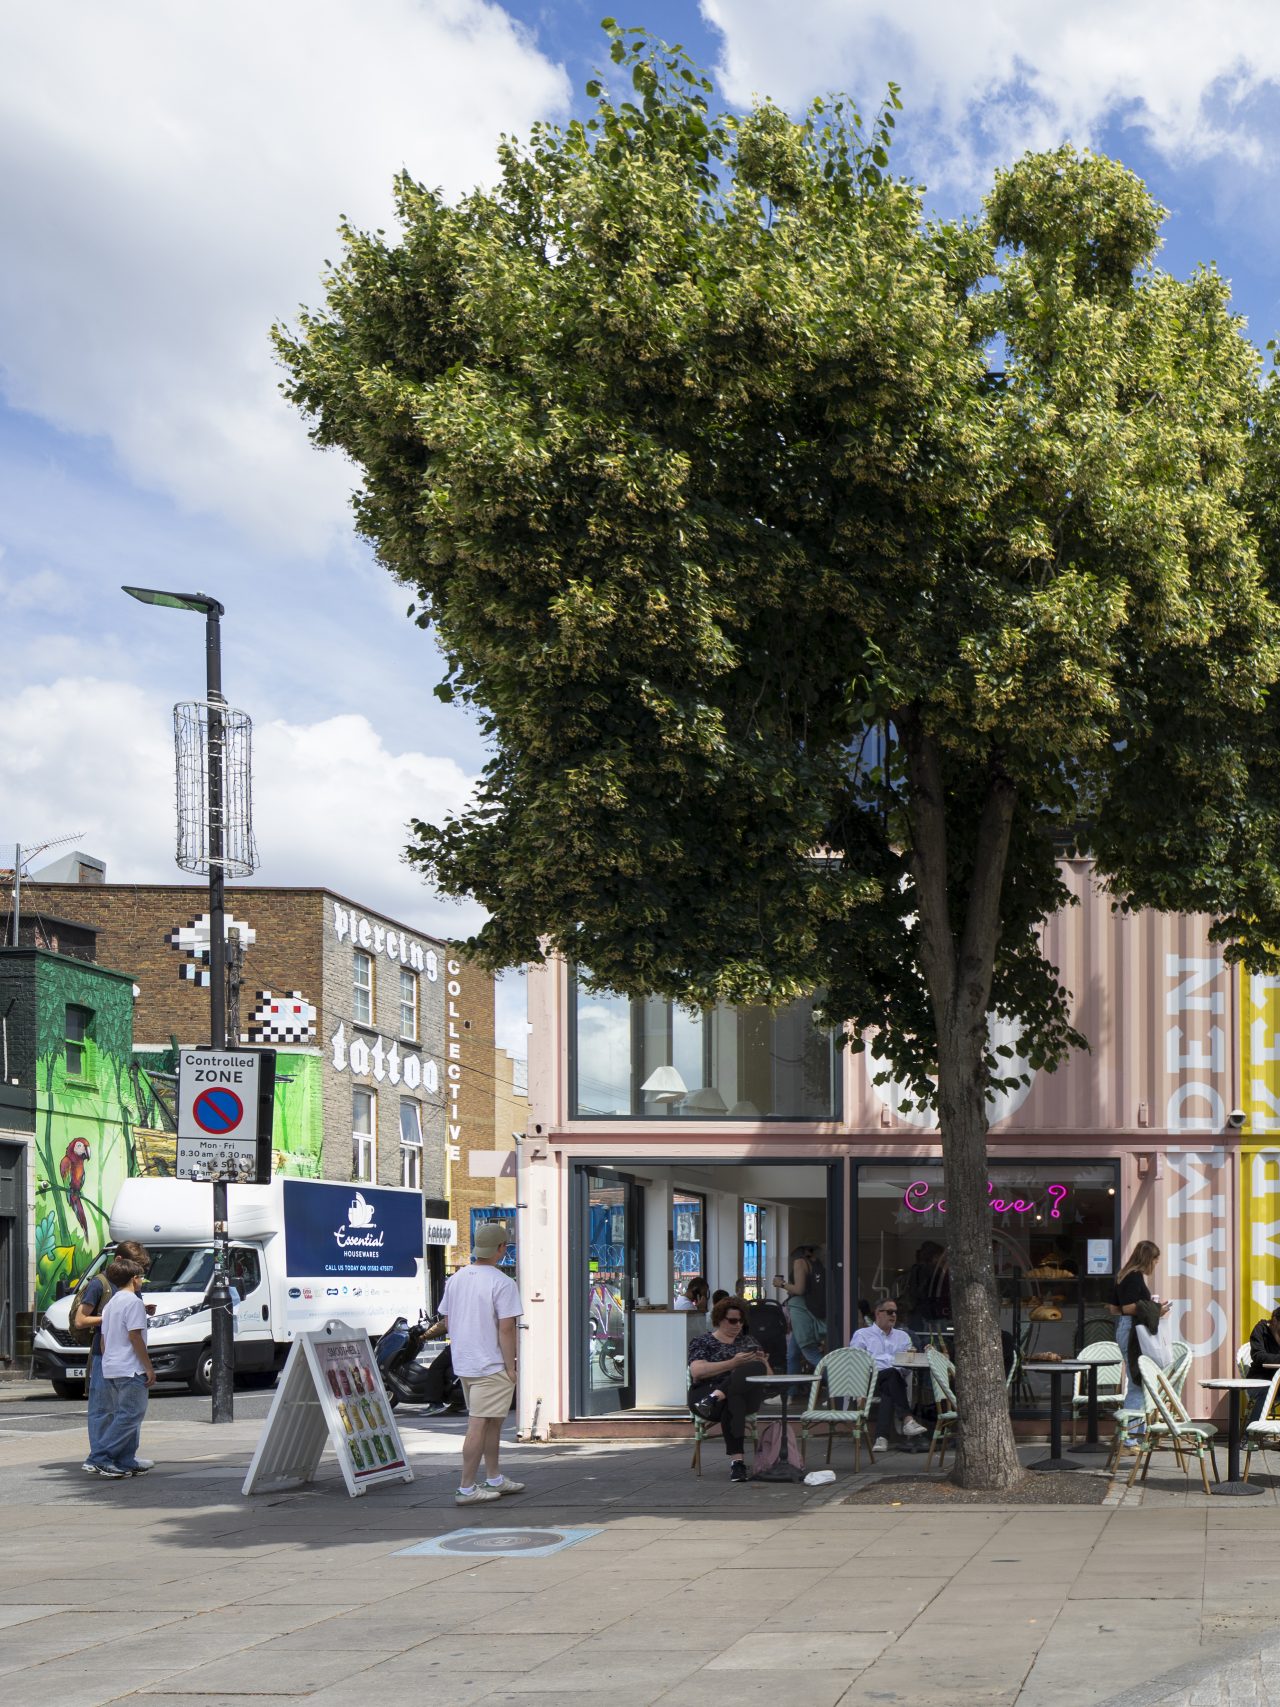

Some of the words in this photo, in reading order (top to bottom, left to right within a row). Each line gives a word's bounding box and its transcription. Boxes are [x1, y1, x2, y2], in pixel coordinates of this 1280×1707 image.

[333, 902, 438, 982] piercing
[185, 1054, 255, 1068] Controlled
[194, 1069, 243, 1083] ZONE
[331, 1020, 439, 1094] tattoo
[447, 959, 461, 1161] COLLECTIVE
[1166, 953, 1227, 1358] CAMDEN
[333, 1225, 384, 1248] Essential
[343, 1250, 379, 1258] HOUSEWARES
